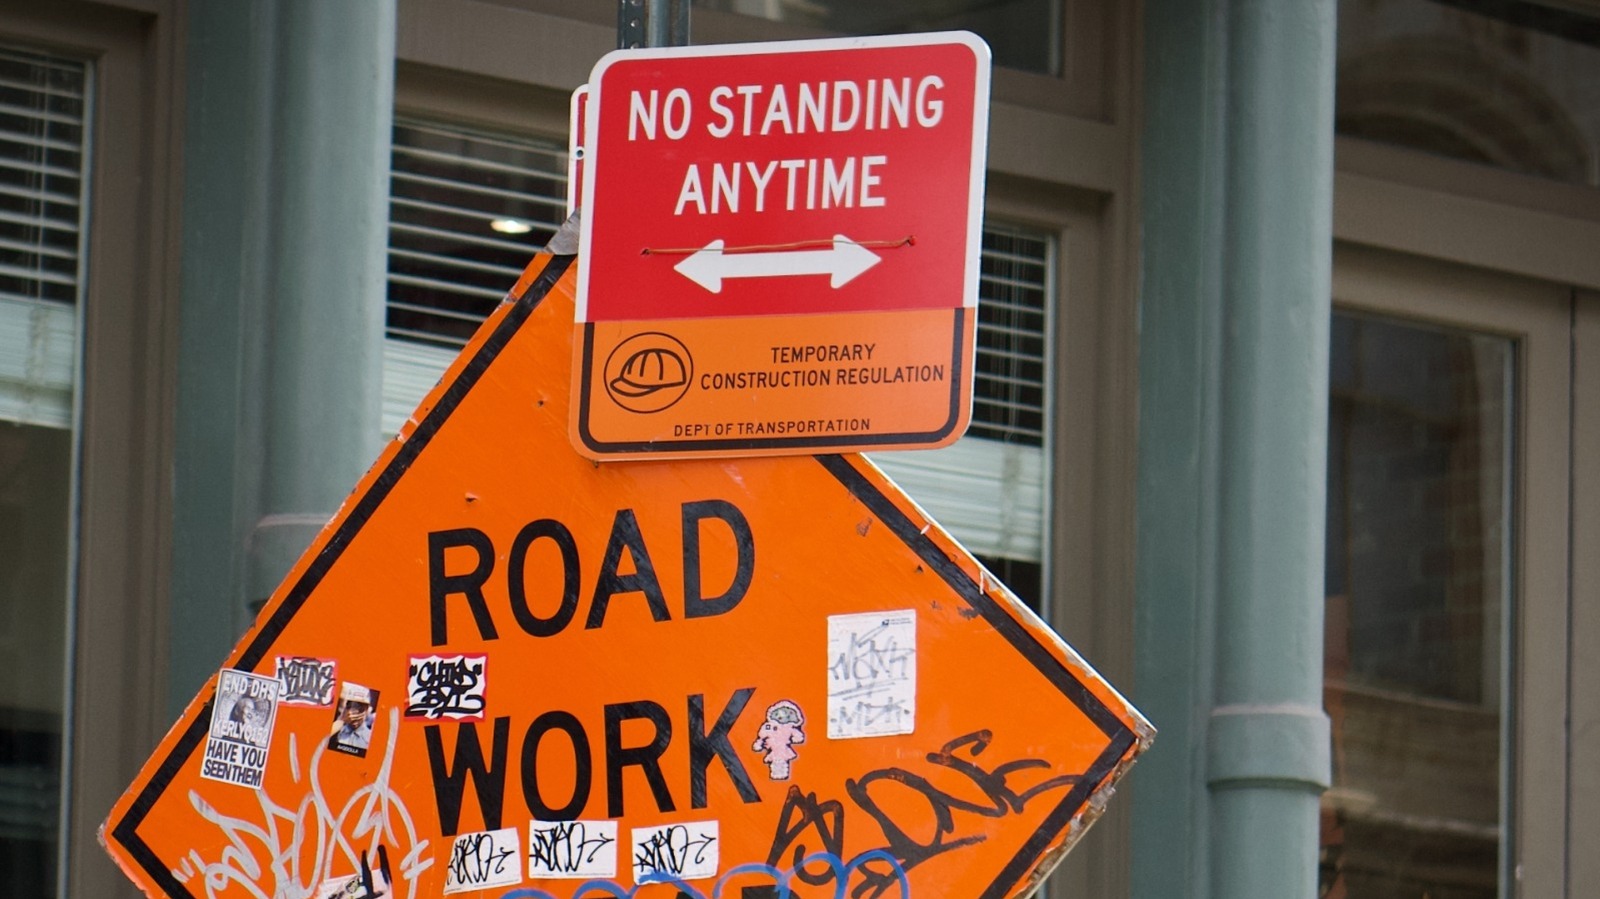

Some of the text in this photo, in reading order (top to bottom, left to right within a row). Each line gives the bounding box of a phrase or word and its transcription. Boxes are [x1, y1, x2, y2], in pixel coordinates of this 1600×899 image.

[628, 75, 945, 142] NO STANDING
[673, 155, 887, 216] ANYTIME
[771, 343, 876, 364] TEMPORARY
[701, 364, 945, 391] CONSTRUCTION REGULATION
[673, 418, 871, 437] DEPT OF TRANSPORTATION
[428, 499, 756, 647] ROAD
[206, 739, 267, 769] HAVE YOU
[424, 687, 763, 836] WORK
